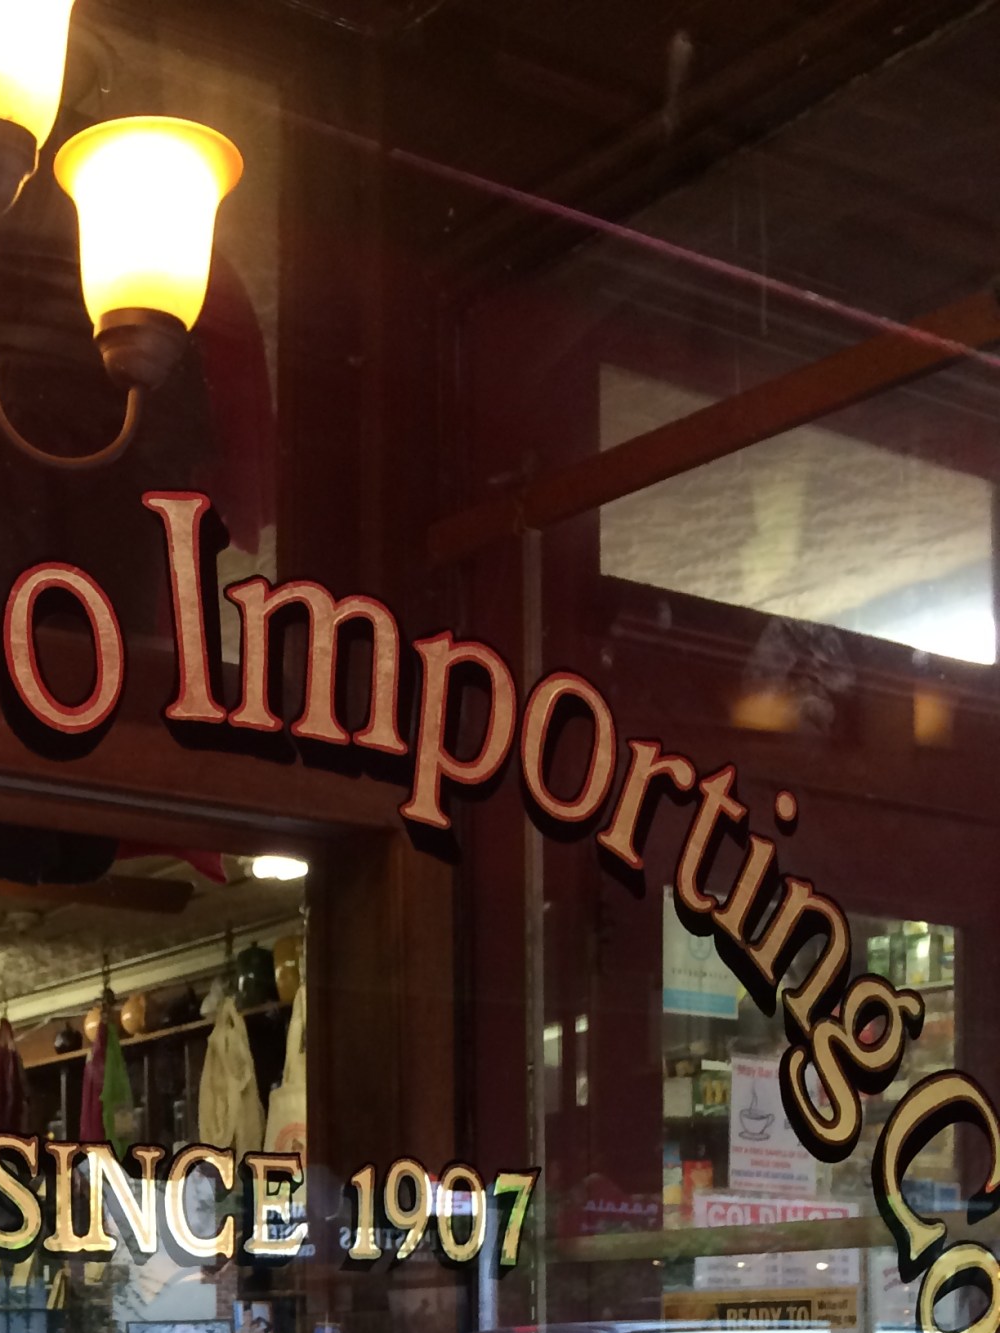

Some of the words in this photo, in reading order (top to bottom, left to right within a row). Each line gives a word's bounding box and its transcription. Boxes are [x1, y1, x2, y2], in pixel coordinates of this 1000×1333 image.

[142, 490, 922, 1148] Importing
[349, 1157, 541, 1267] 1907
[707, 1203, 776, 1226] COLD
